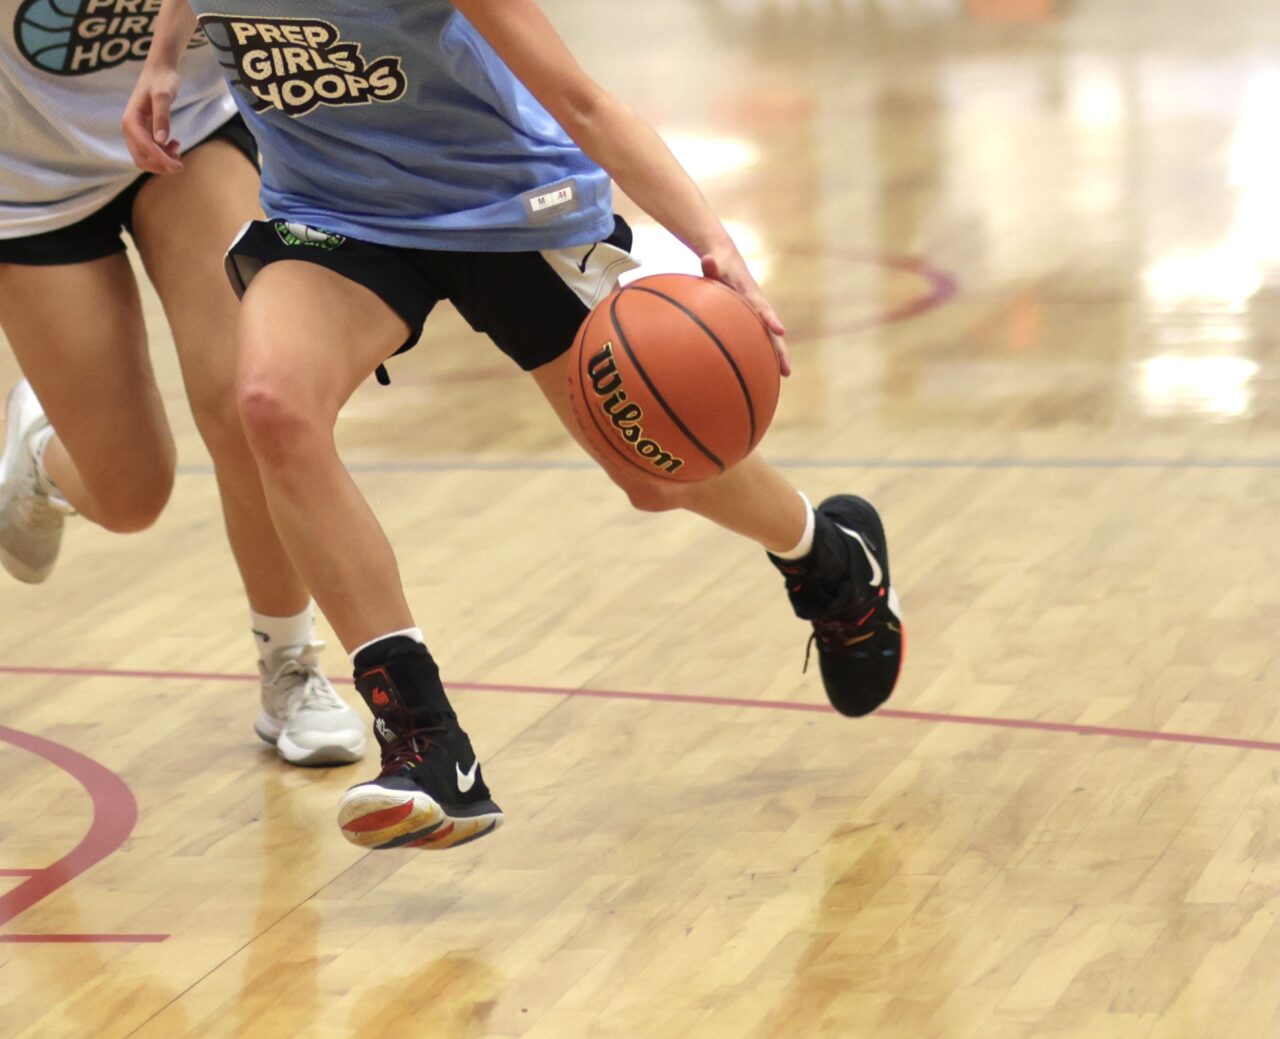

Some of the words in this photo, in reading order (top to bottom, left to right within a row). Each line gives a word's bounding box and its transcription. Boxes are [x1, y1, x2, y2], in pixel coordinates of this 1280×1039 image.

[230, 22, 329, 48] PREP
[70, 36, 152, 71] HOO
[242, 47, 356, 81] GIRLS
[251, 66, 397, 110] HOOPS
[587, 342, 684, 473] Wilson
